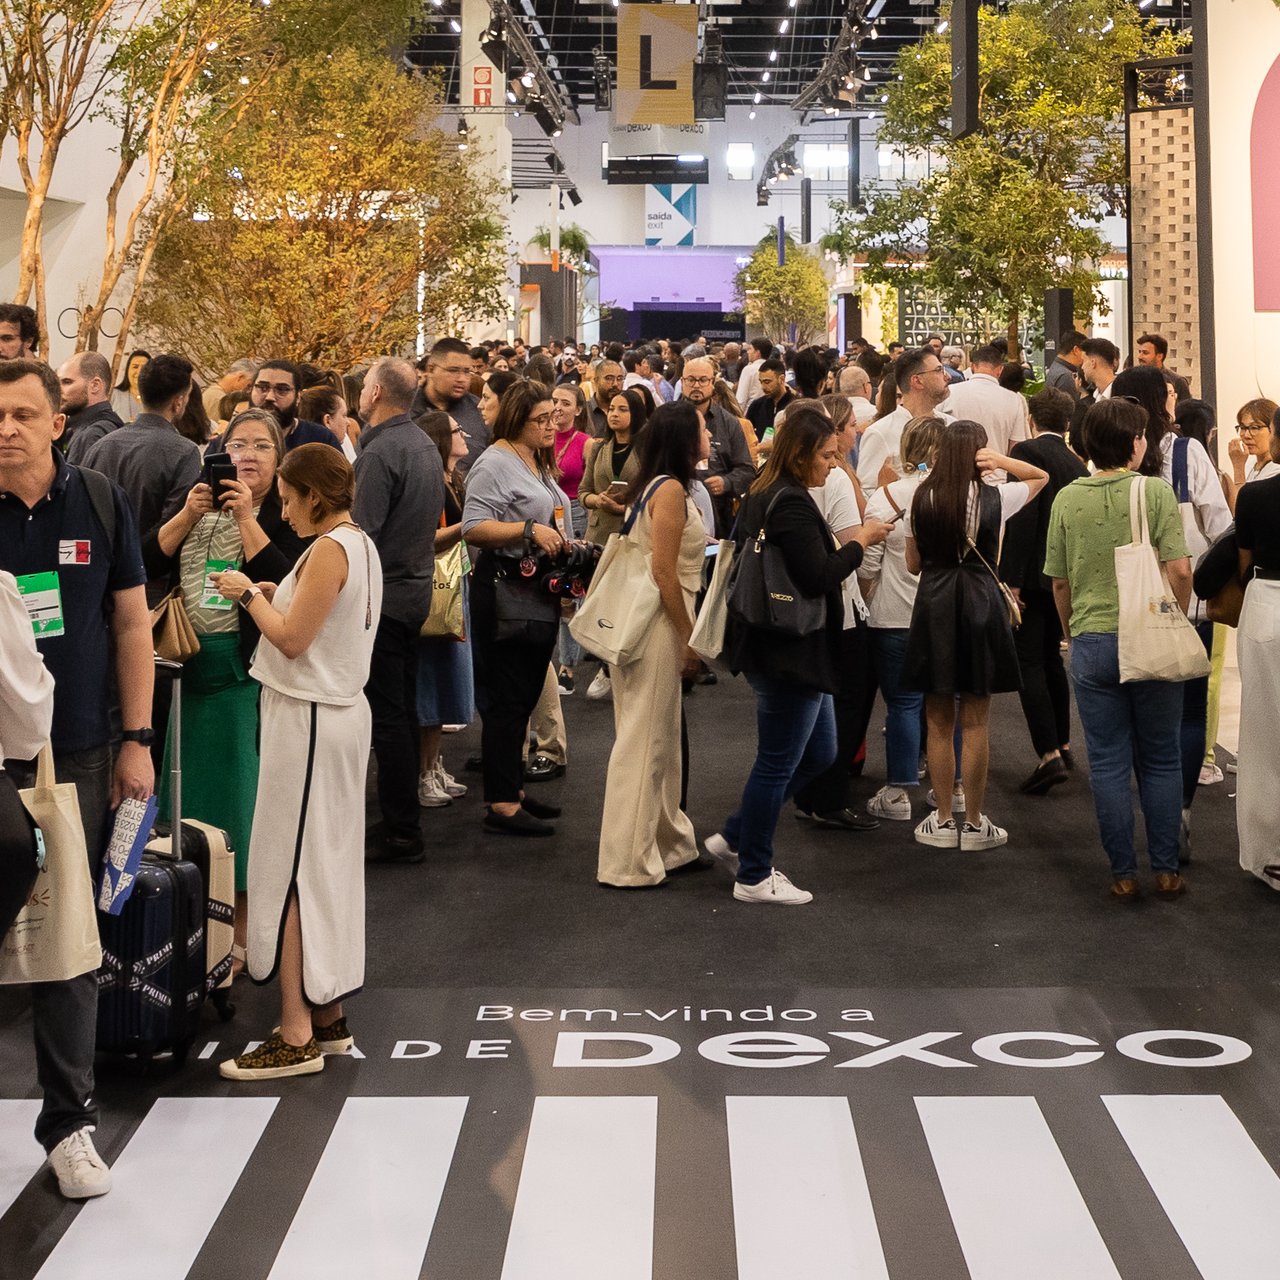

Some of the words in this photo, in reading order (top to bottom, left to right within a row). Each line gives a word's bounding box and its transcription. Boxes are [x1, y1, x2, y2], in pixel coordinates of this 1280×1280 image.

[639, 35, 676, 90] L
[647, 222, 664, 230] exit
[475, 1005, 817, 1022] Bem-vindo
[840, 1008, 875, 1022] a
[551, 1029, 1253, 1069] Dexco
